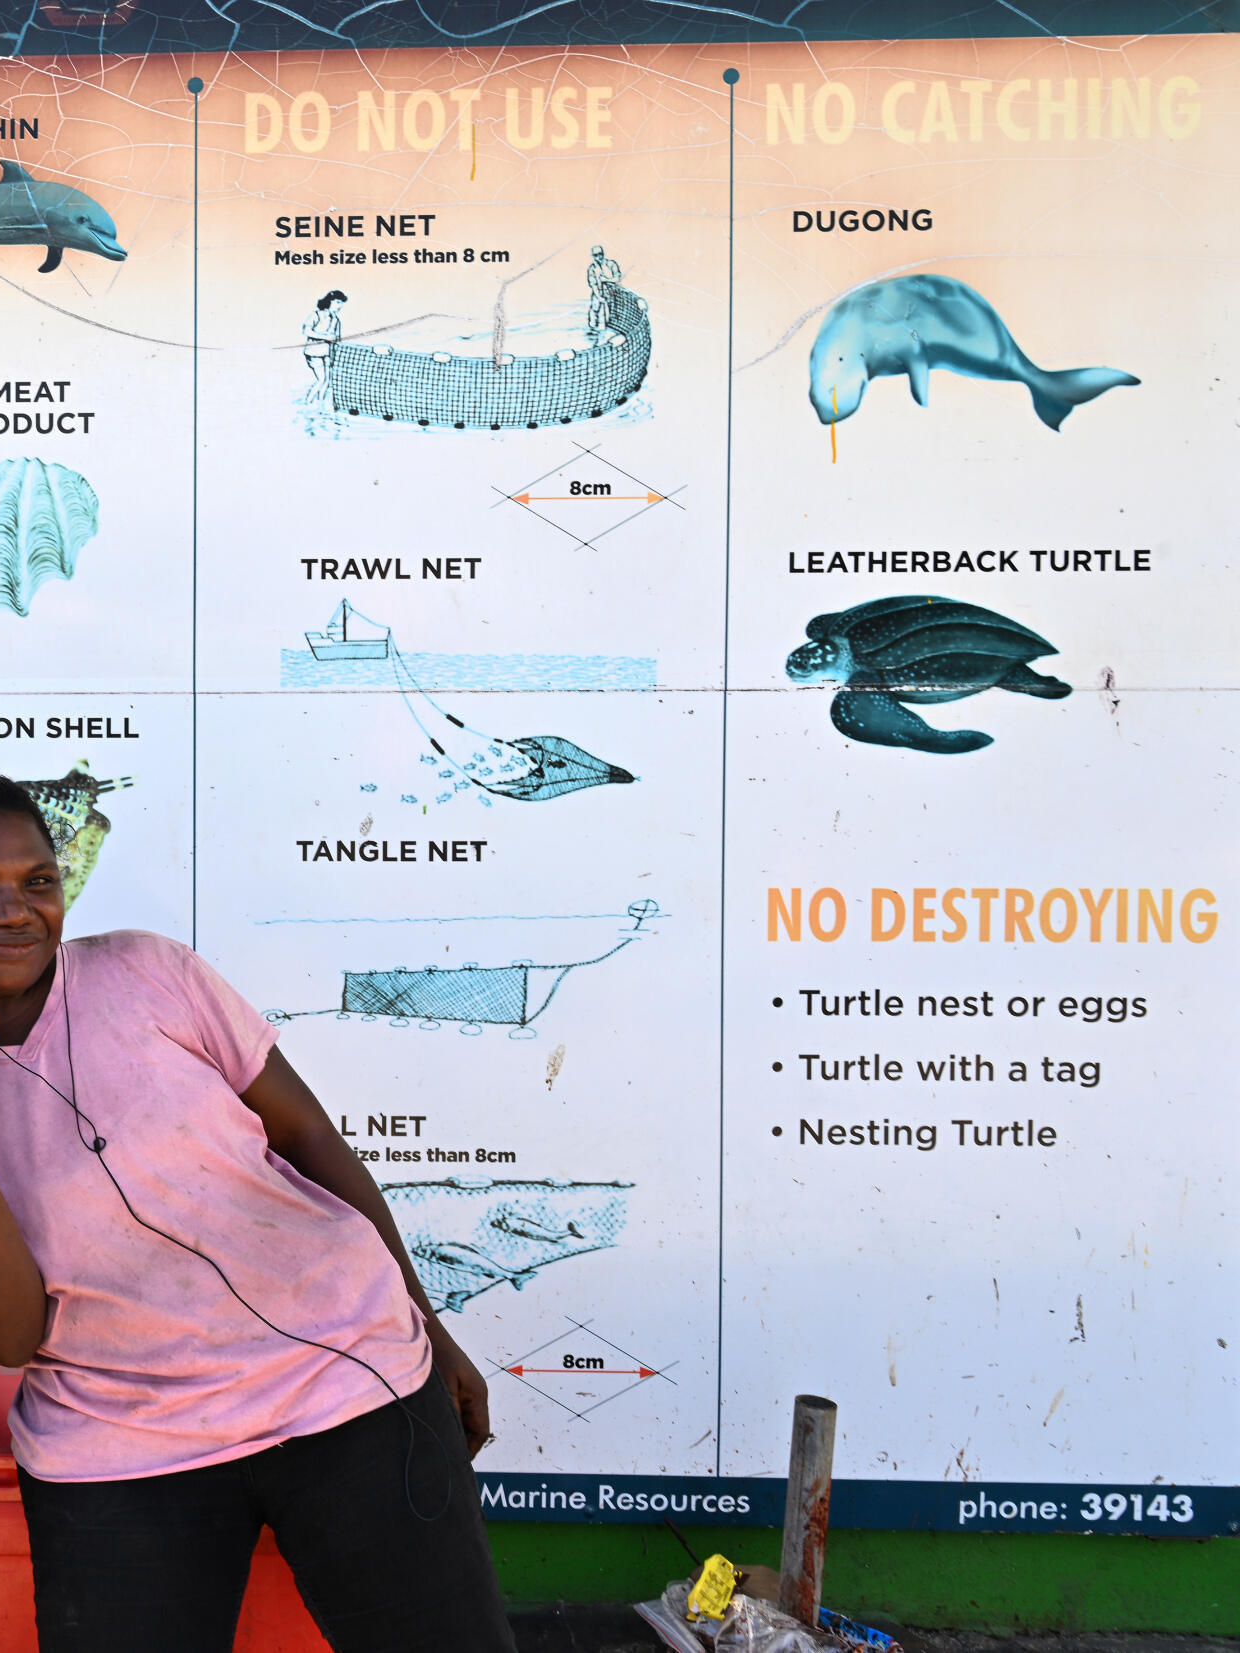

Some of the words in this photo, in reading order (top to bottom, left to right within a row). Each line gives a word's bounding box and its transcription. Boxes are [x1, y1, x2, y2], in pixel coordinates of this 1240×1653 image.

[245, 92, 330, 153] DO
[358, 89, 480, 151] NOT
[506, 87, 612, 149] USE
[766, 83, 856, 144] NO
[882, 77, 1202, 142] CATCHING
[276, 216, 364, 238] SEINE
[376, 215, 435, 236] NET
[794, 209, 932, 232] DUGONG
[275, 250, 323, 265] Mesh
[330, 250, 366, 264] size
[373, 249, 408, 263] less
[414, 249, 457, 263] than
[463, 248, 474, 262] 8
[481, 251, 509, 262] cm
[570, 481, 611, 495] 8cm
[301, 559, 410, 579] TRAWL
[423, 558, 481, 579] NET
[790, 551, 1018, 573] LEATHERBACK
[1030, 550, 1150, 571] TURTLE
[47, 718, 139, 738] SHELL
[297, 840, 416, 862] TANGLE
[429, 841, 487, 861] NET
[767, 888, 847, 942] NO
[870, 888, 1219, 943] DESTROYING
[799, 989, 903, 1016] Turtle
[919, 992, 993, 1016] nest
[1008, 997, 1045, 1017] or
[1059, 997, 1147, 1023] eggs
[799, 1054, 902, 1081] Turtle
[917, 1055, 993, 1081] with
[1009, 1062, 1026, 1081] a
[1042, 1057, 1100, 1087] tag
[368, 1113, 426, 1136] NET
[800, 1119, 936, 1151] Nesting
[952, 1120, 1056, 1147] Turtle
[354, 1147, 381, 1163] ize
[386, 1147, 421, 1162] less
[427, 1148, 469, 1162] than
[475, 1149, 515, 1162] 8cm
[563, 1355, 604, 1369] 8cm
[481, 1483, 586, 1509] Marine
[599, 1485, 750, 1512] Resources
[959, 1492, 1067, 1524] phone:
[1081, 1493, 1193, 1522] 39143
